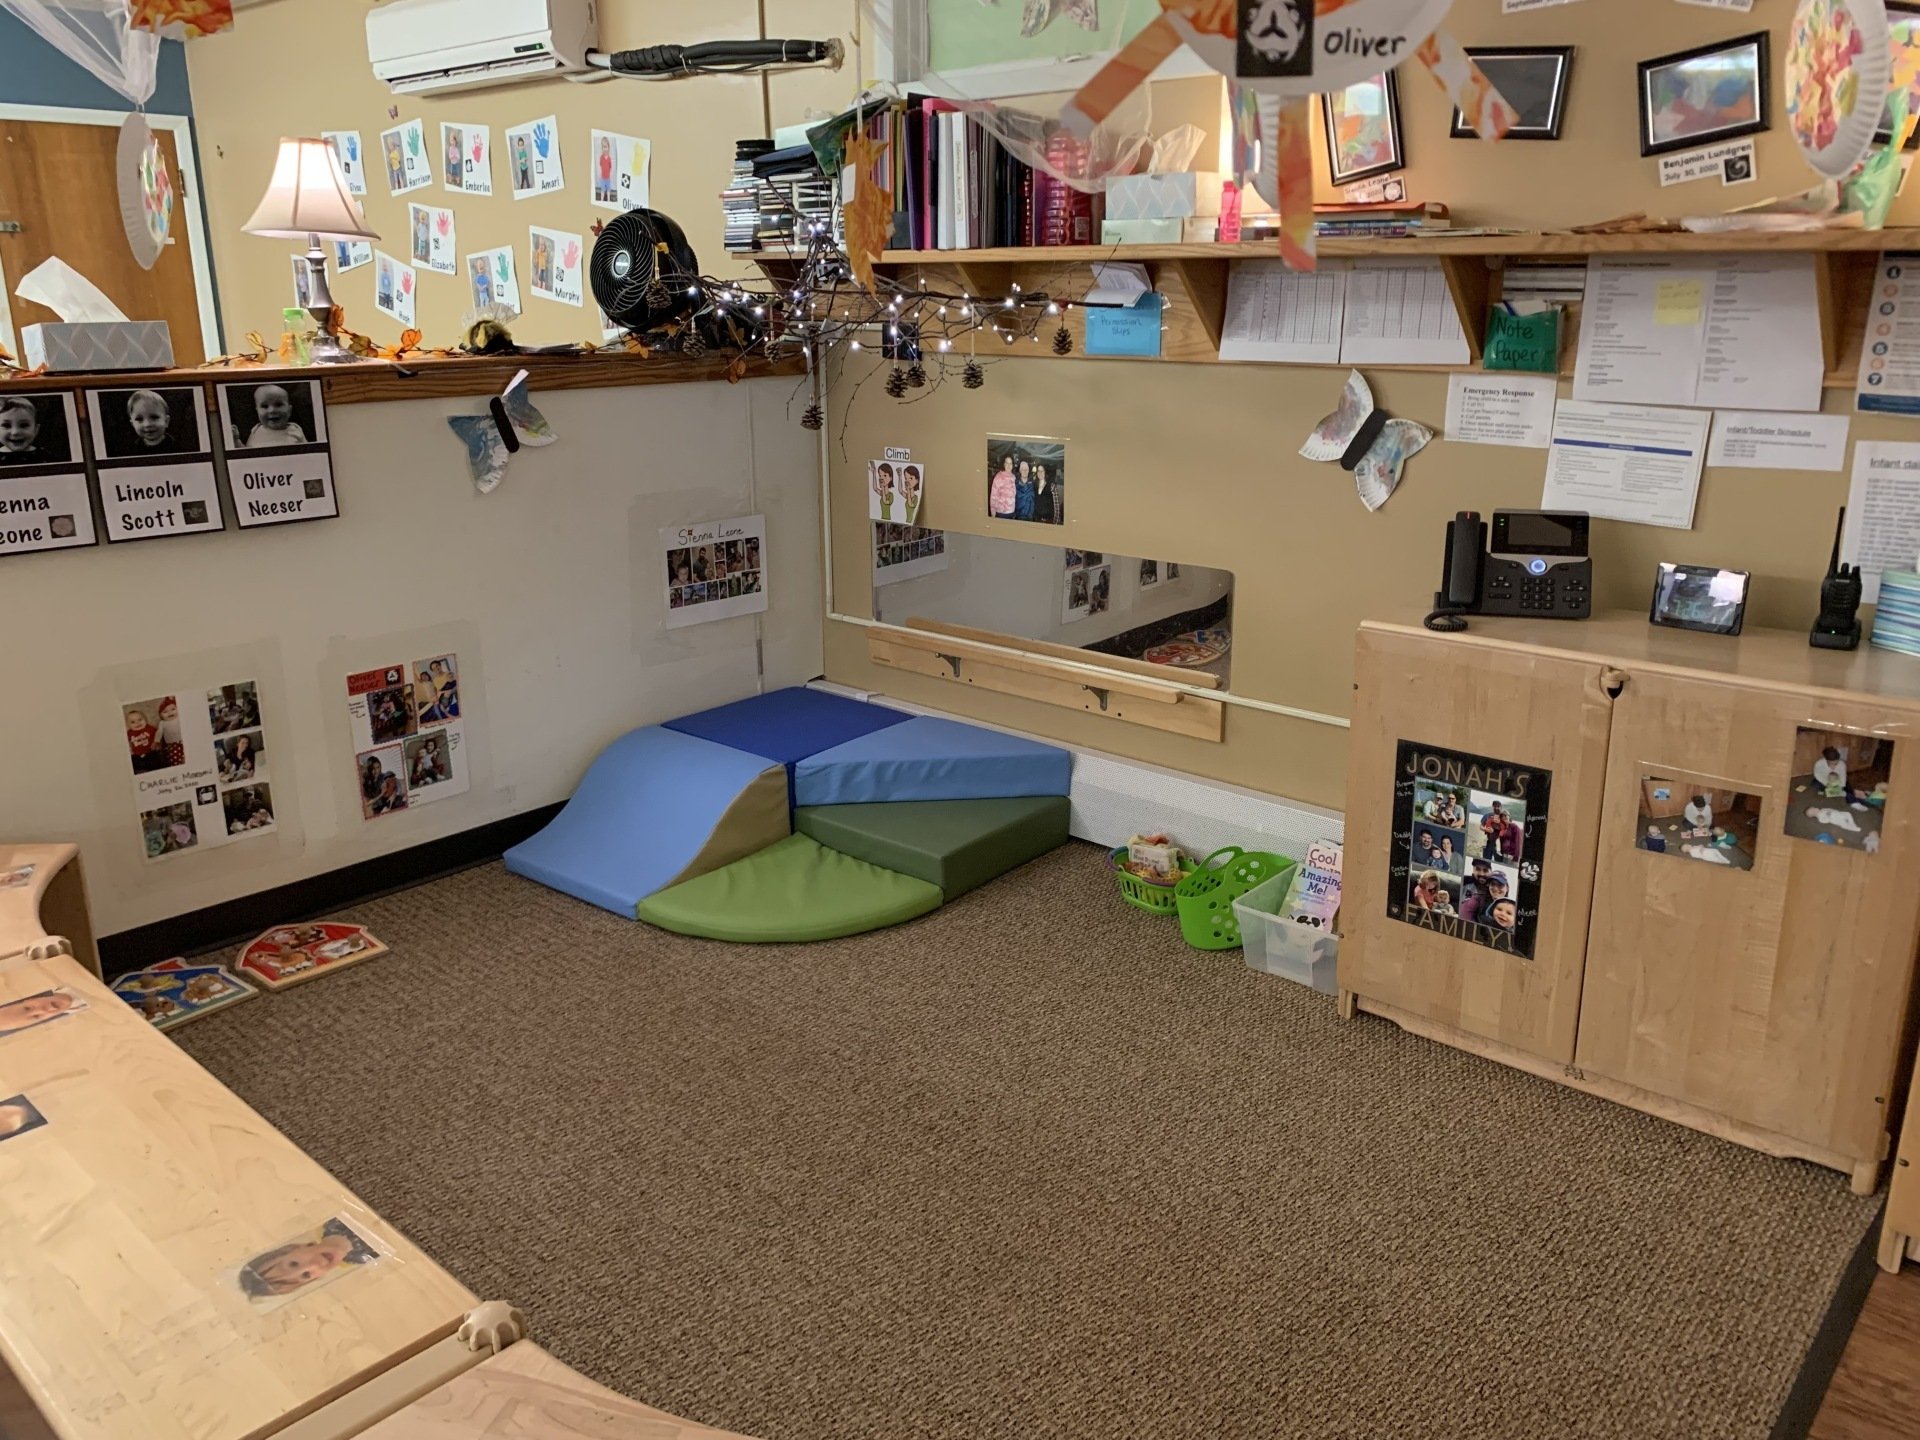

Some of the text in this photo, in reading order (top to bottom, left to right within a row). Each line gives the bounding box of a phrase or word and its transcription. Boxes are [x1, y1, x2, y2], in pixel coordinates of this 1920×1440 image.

[1323, 27, 1407, 57] Oliver
[1663, 143, 1752, 169] Benjamin Lundgren
[1699, 163, 1719, 174] 2020
[541, 178, 560, 191] Amari
[431, 258, 455, 271] Elizabeth
[554, 287, 580, 303] Murphy
[1496, 316, 1534, 339] Note
[1495, 340, 1538, 369] Paper
[1463, 386, 1535, 398] Emergency Response
[1727, 426, 1811, 437] Infant/Toddler Schedule
[885, 448, 911, 460] Climb
[1870, 457, 1901, 468] Infant
[243, 472, 294, 490] Oliver
[116, 480, 184, 502] Lincoln
[0, 497, 50, 514] enna
[248, 499, 303, 517] Neeser
[122, 509, 175, 531] Scott
[0, 526, 43, 545] eone
[678, 524, 744, 545] Sienna Leone
[1406, 751, 1530, 798] JONAH'S
[1310, 848, 1337, 866] Cool
[1298, 867, 1342, 891] Amazing
[1307, 881, 1329, 896] Me!
[1405, 903, 1514, 952] FAMILY!
